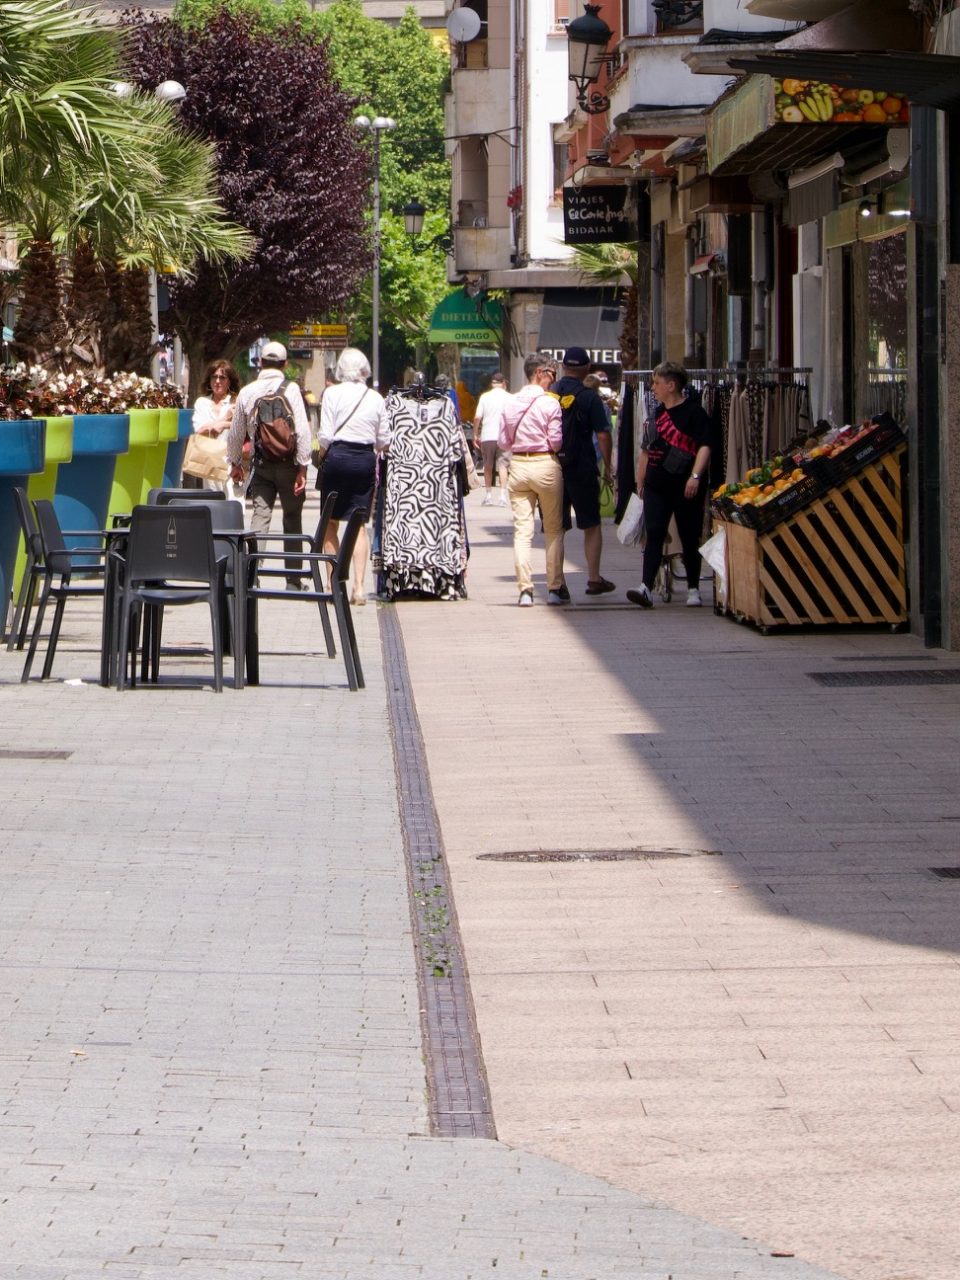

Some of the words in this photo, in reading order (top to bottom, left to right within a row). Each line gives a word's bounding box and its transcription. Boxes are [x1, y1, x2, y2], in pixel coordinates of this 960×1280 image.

[568, 195, 604, 205] VIAJES
[568, 208, 579, 220] El
[580, 208, 605, 220] Corte
[568, 226, 614, 235] BIDAIAK
[454, 332, 490, 340] OMAGO
